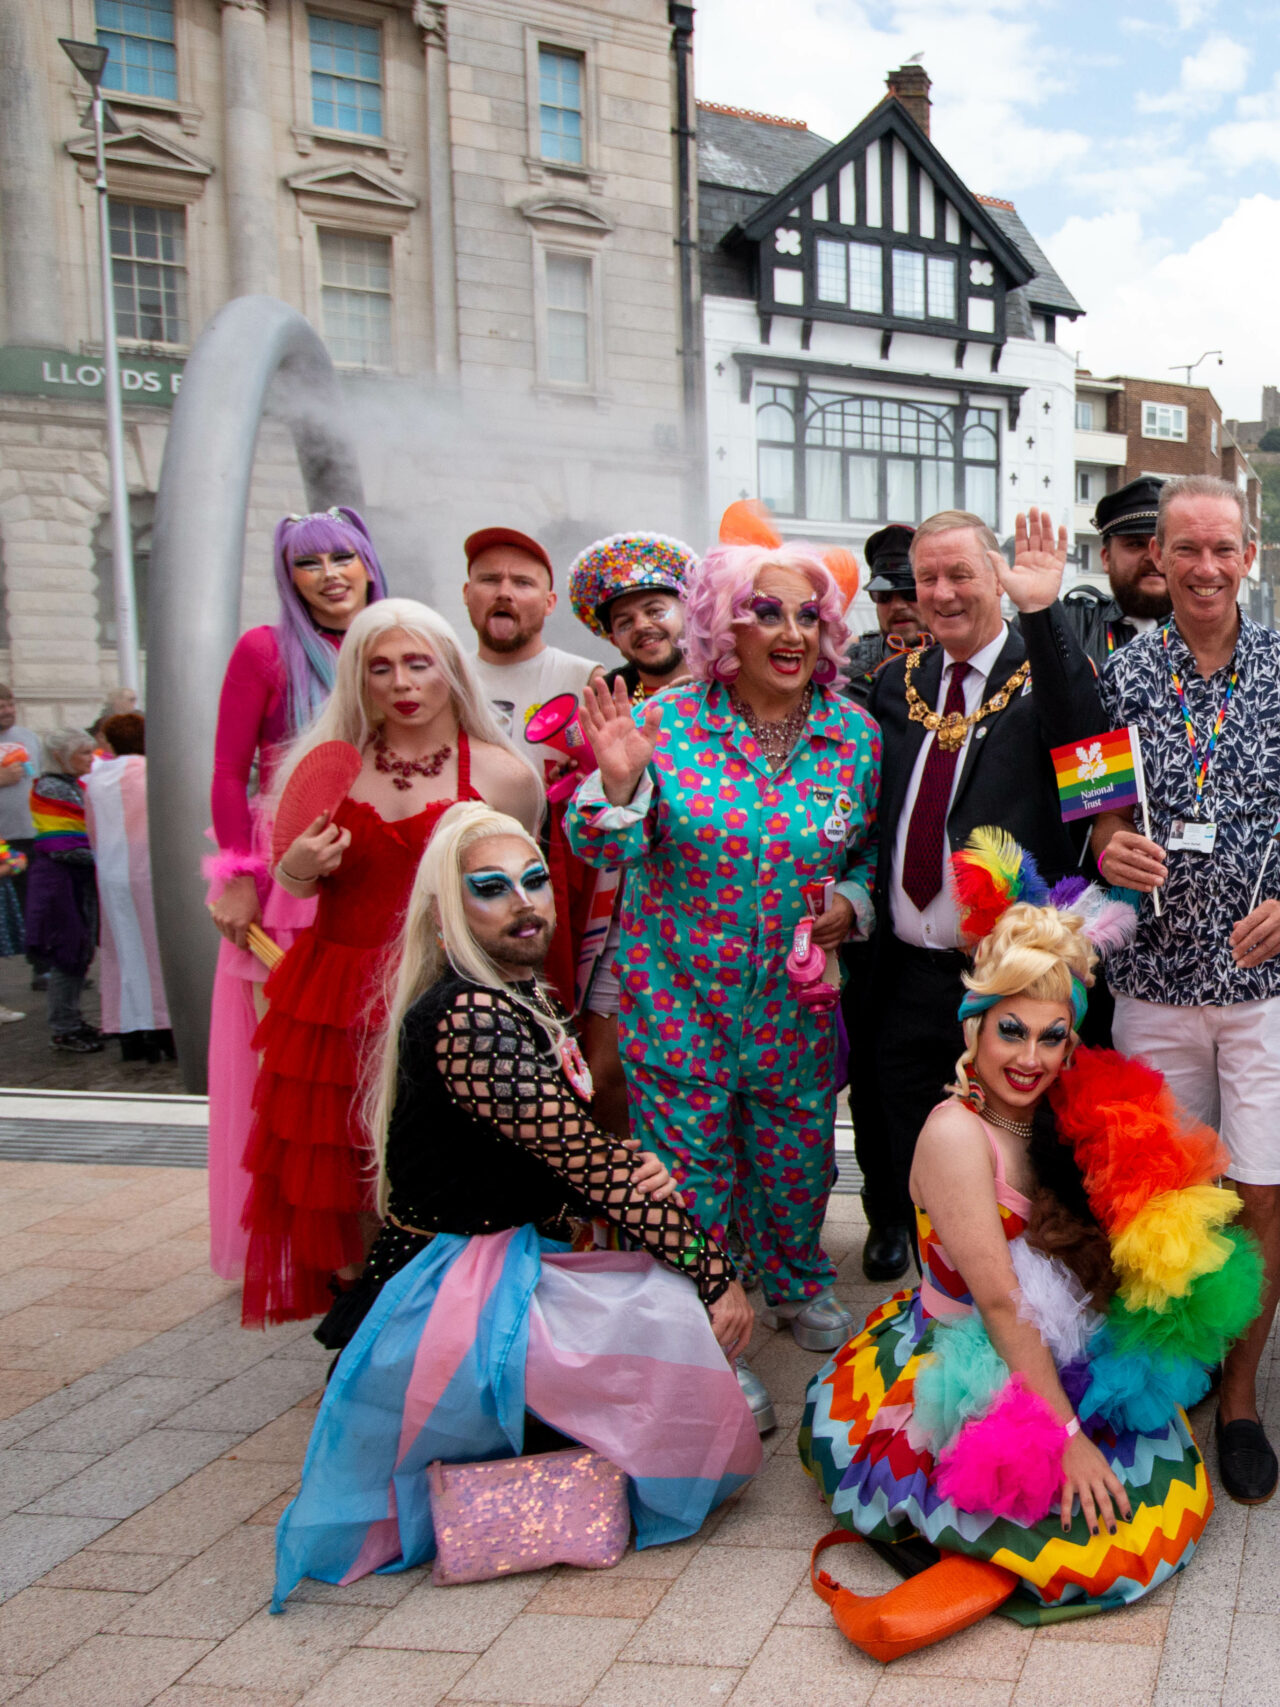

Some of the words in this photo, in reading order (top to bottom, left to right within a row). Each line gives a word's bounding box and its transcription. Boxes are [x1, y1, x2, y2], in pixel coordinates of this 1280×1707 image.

[42, 361, 162, 393] LLODS
[1080, 782, 1114, 800] National
[1082, 798, 1102, 811] Trust
